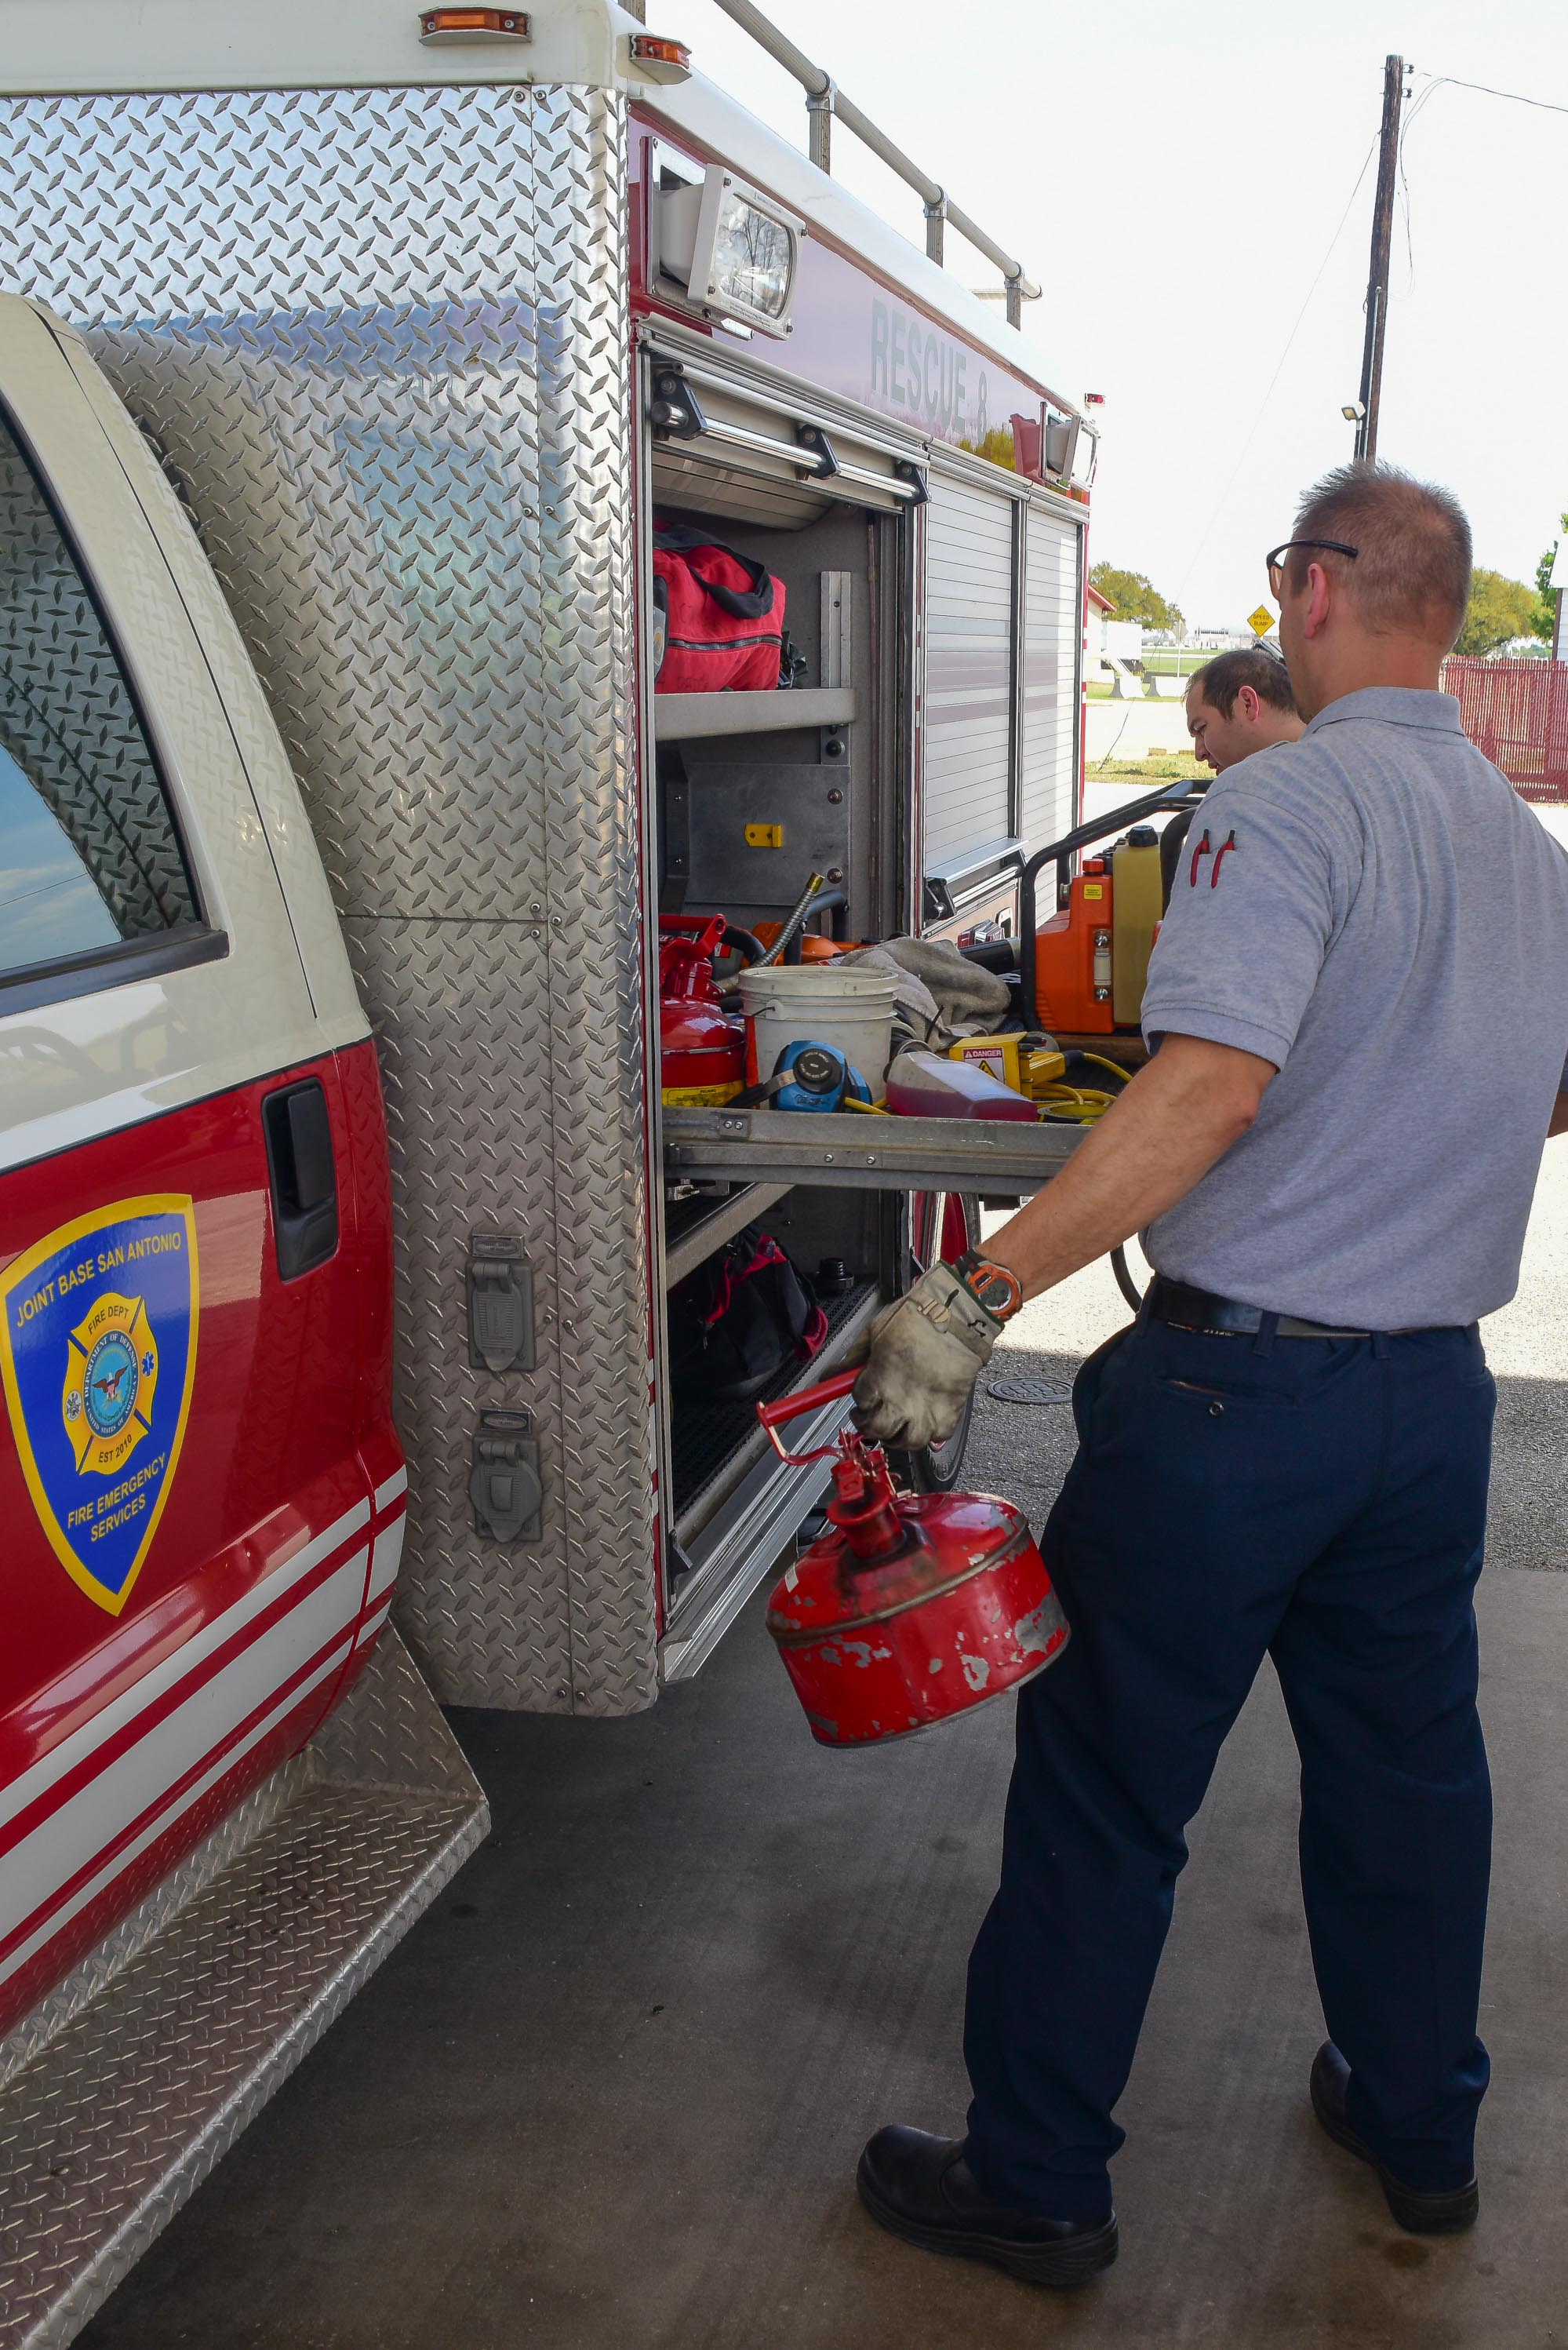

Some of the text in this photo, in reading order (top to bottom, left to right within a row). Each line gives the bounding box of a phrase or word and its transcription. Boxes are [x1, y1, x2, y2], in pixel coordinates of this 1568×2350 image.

[871, 297, 988, 445] RESCUE 8
[16, 1232, 181, 1328] JOINT BASE SAN ANTONIO
[88, 1305, 129, 1335] FIRE DEPT
[84, 1333, 137, 1397] DEPARTMENT OF DEFENSE
[87, 1409, 100, 1430] UNITED
[125, 1381, 136, 1415] AMERICA
[98, 1434, 133, 1463] EST 2010
[67, 1452, 166, 1529] FIRE EMERGENCY
[90, 1492, 147, 1542] SERVICES
